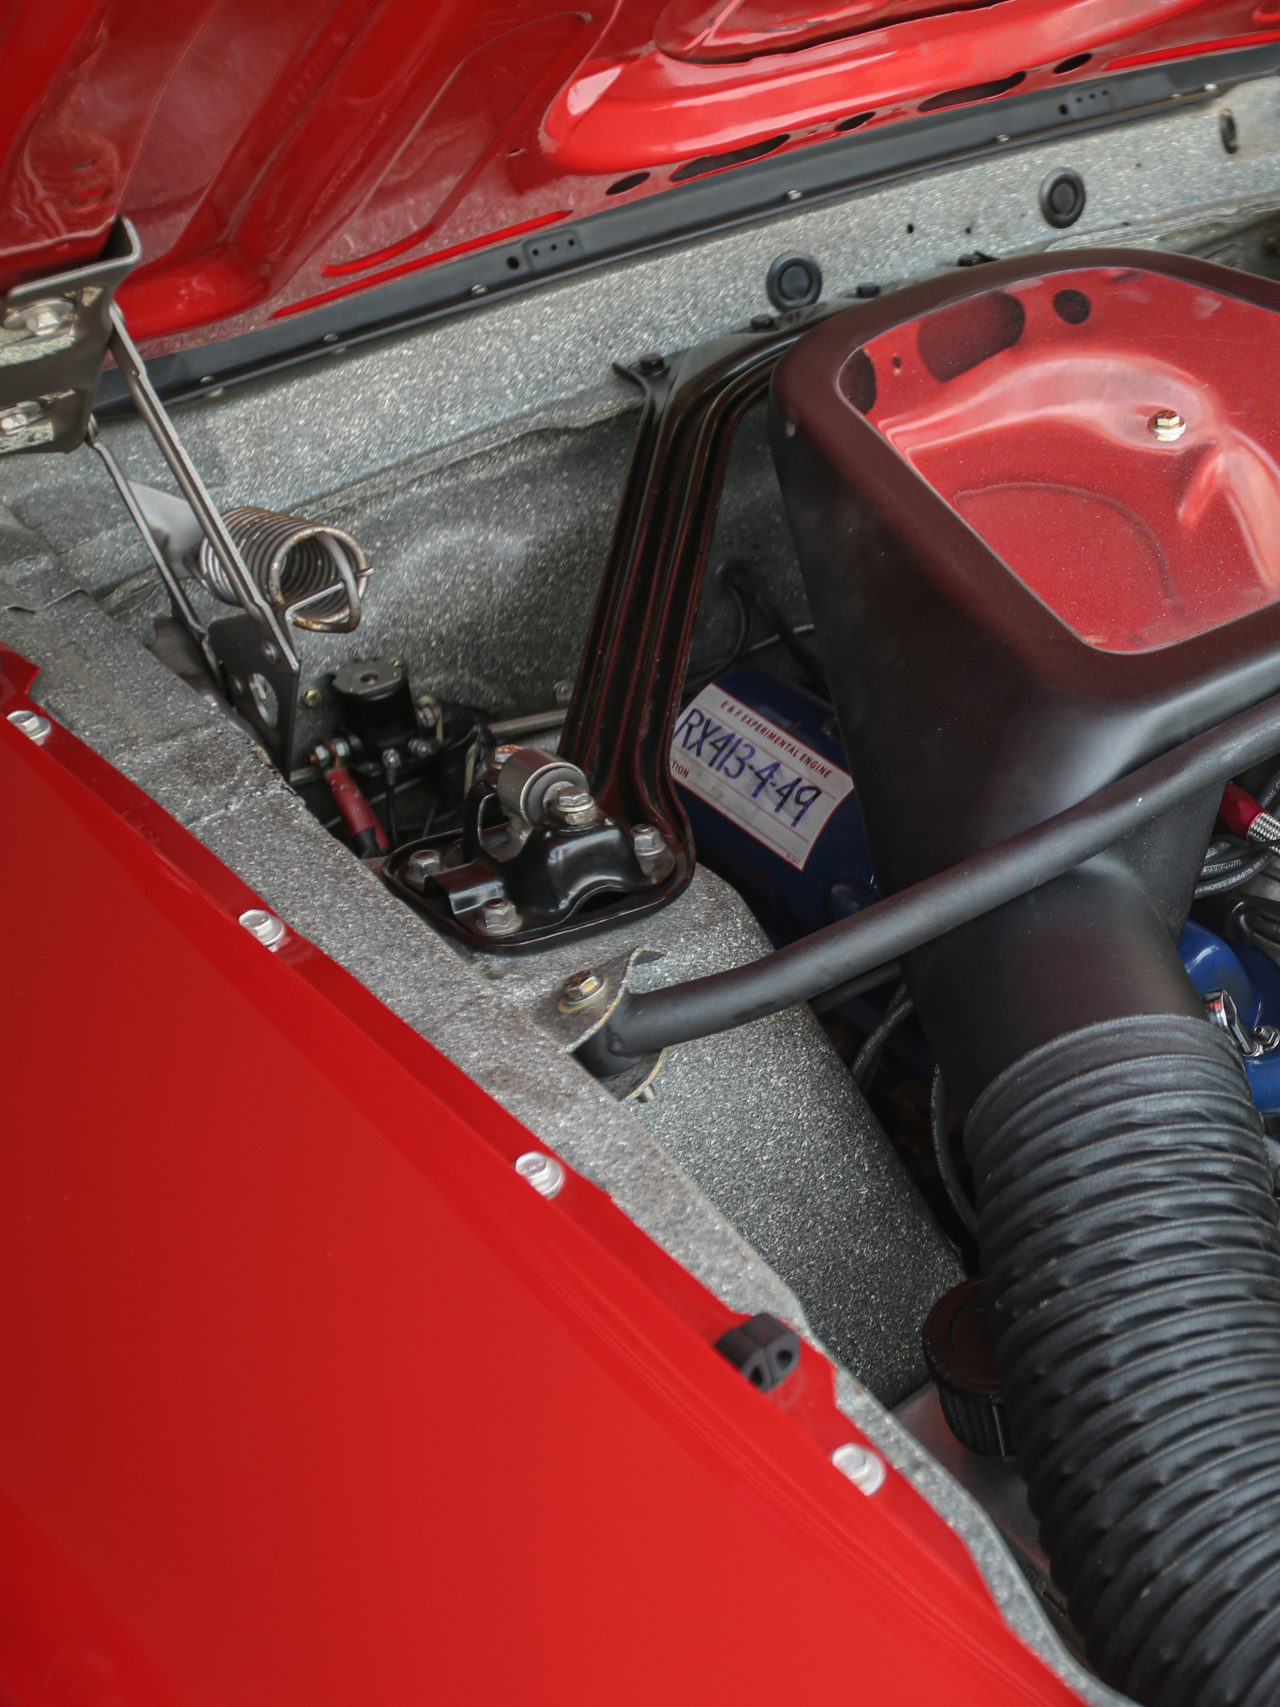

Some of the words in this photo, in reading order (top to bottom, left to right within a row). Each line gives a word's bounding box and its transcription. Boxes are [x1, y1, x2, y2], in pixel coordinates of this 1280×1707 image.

[672, 707, 823, 828] RX413-4-49
[740, 713, 800, 758] EXPERIMENTAL
[799, 752, 832, 779] ENGINE
